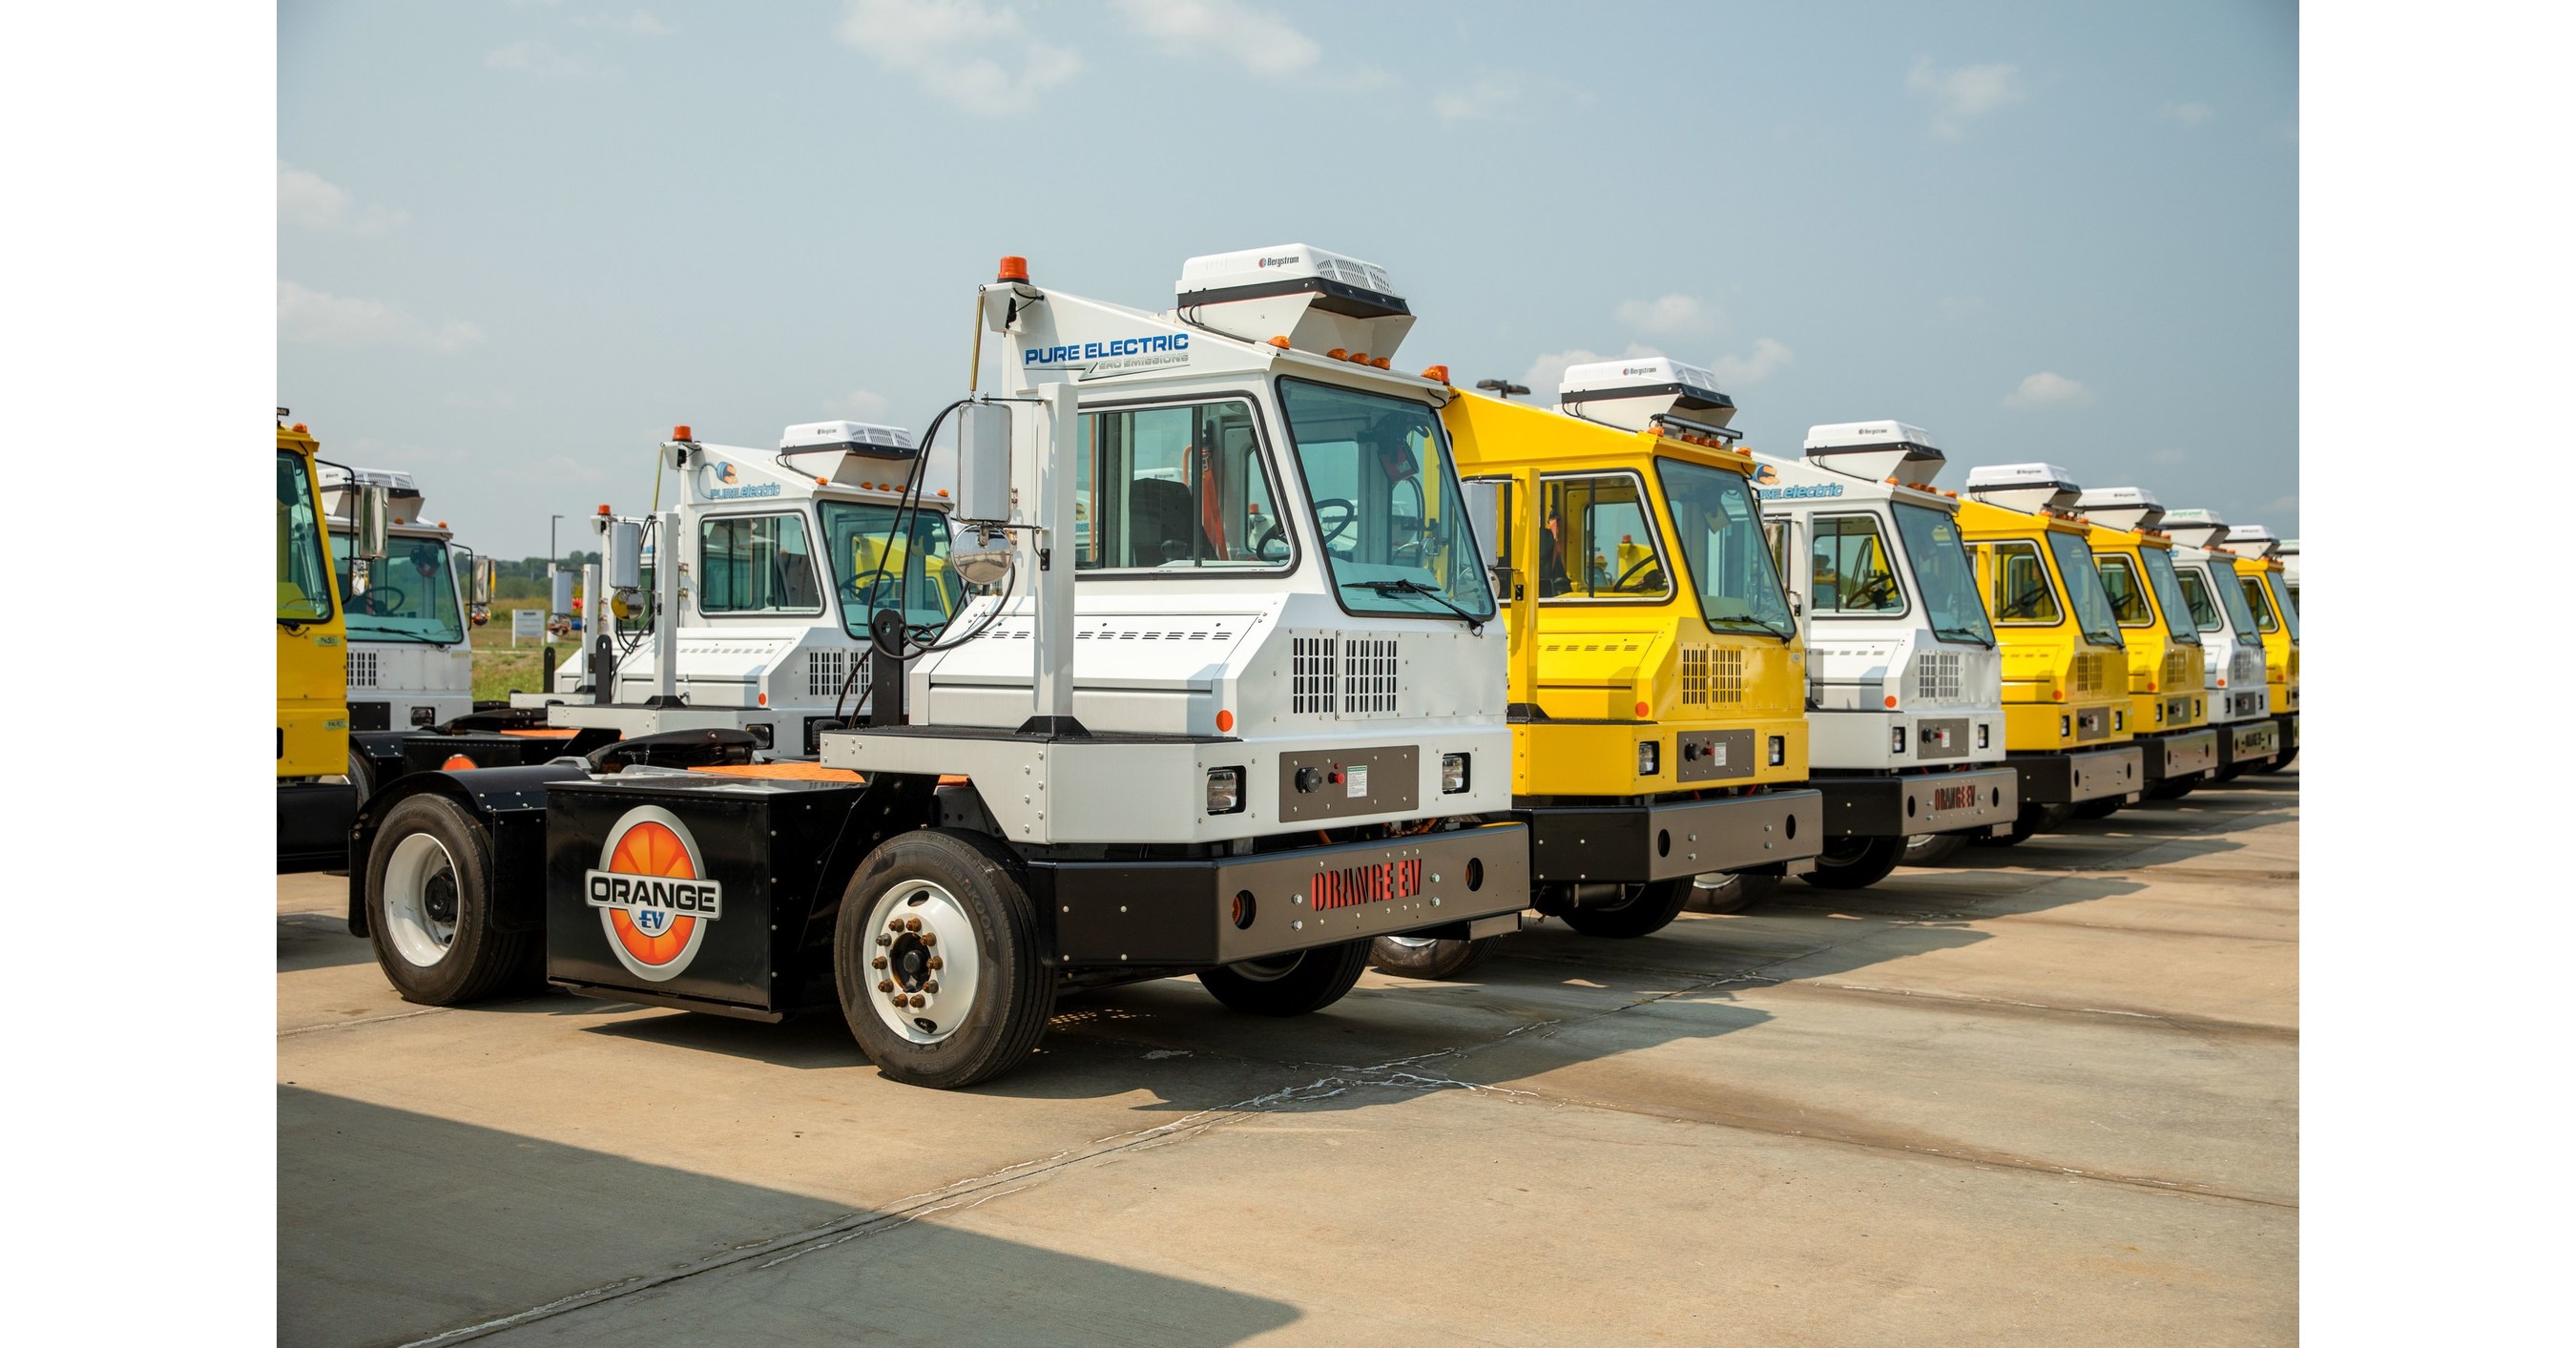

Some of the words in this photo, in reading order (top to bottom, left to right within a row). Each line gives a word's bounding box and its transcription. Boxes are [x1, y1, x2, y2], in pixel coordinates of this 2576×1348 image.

[1267, 256, 1299, 267] Bergstrom
[1026, 344, 1080, 364] PURE
[1085, 333, 1190, 360] ELECTRIC
[1123, 352, 1190, 367] EMISSIONS
[740, 482, 780, 498] electric
[1783, 482, 1843, 499] electric
[1935, 786, 1964, 811] ORANGE
[591, 876, 717, 913] ORANGE
[1311, 861, 1394, 912] ORANGE
[1398, 858, 1422, 898] EV
[639, 909, 665, 929] EV
